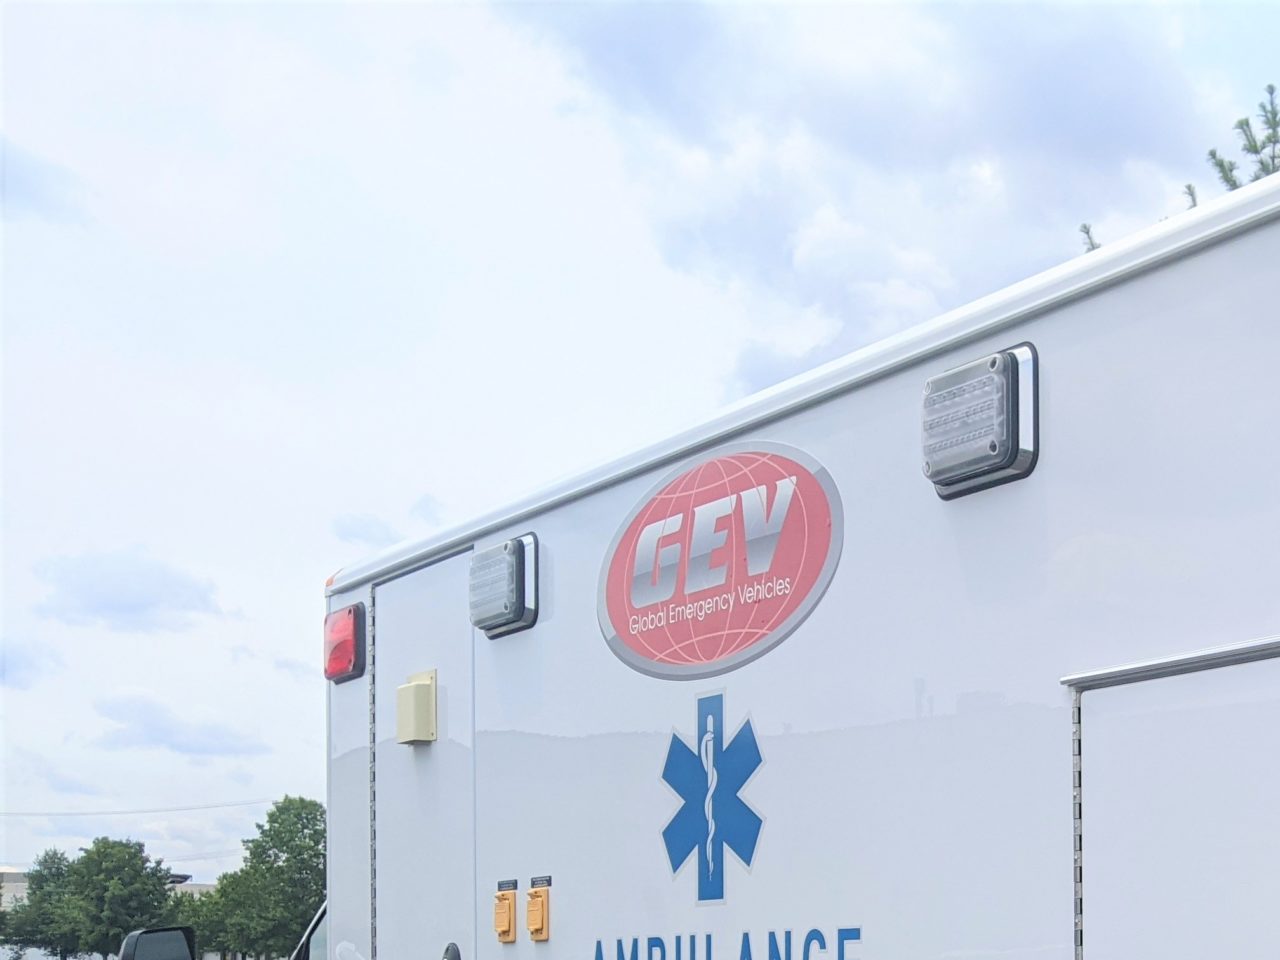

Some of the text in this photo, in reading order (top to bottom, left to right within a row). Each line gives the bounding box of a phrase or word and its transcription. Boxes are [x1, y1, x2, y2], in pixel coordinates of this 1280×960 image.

[629, 475, 797, 609] GEV
[629, 576, 791, 635] Global Emergency Vehicles
